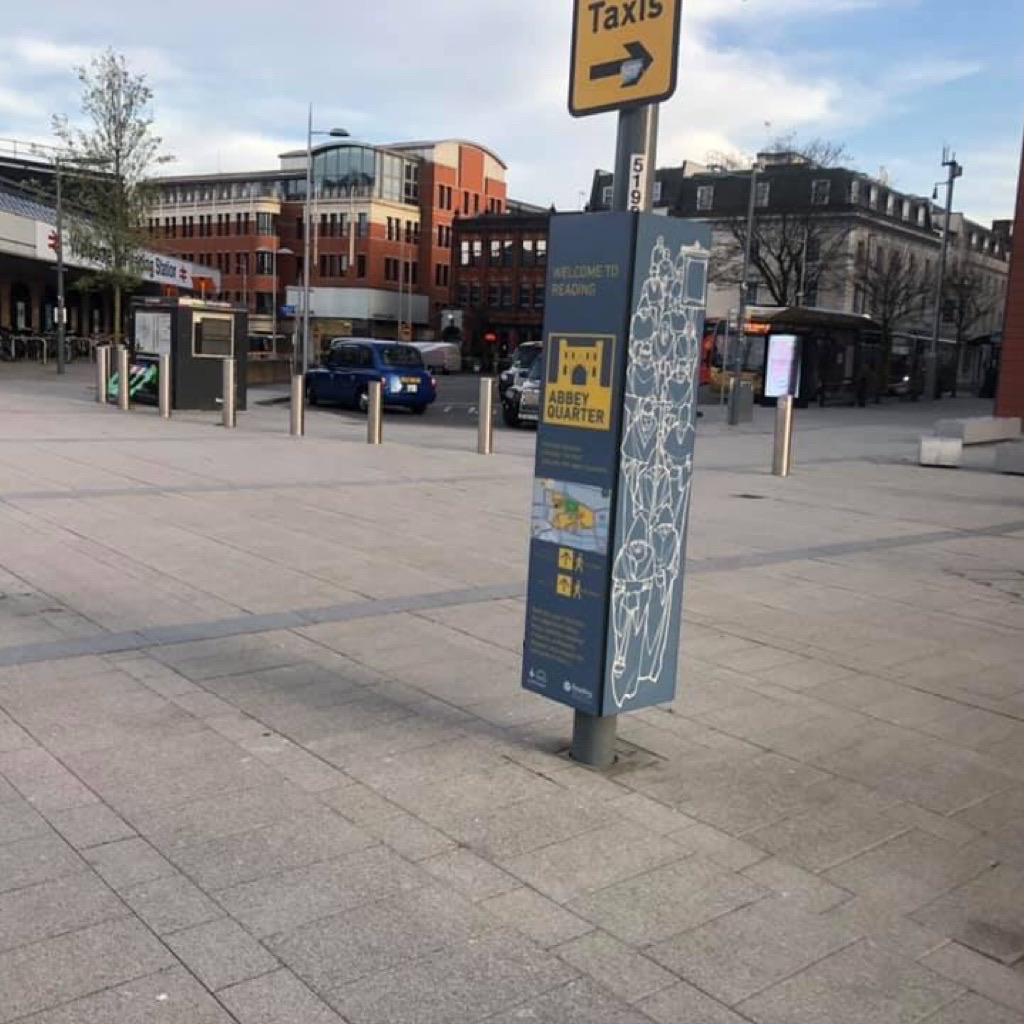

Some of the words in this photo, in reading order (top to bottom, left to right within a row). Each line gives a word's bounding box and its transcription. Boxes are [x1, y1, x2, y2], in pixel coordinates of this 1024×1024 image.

[588, 0, 664, 34] Taxis
[553, 264, 604, 279] WELCOME
[551, 283, 597, 297] READING
[549, 389, 591, 406] ABBEY
[547, 404, 605, 425] QUARTER
